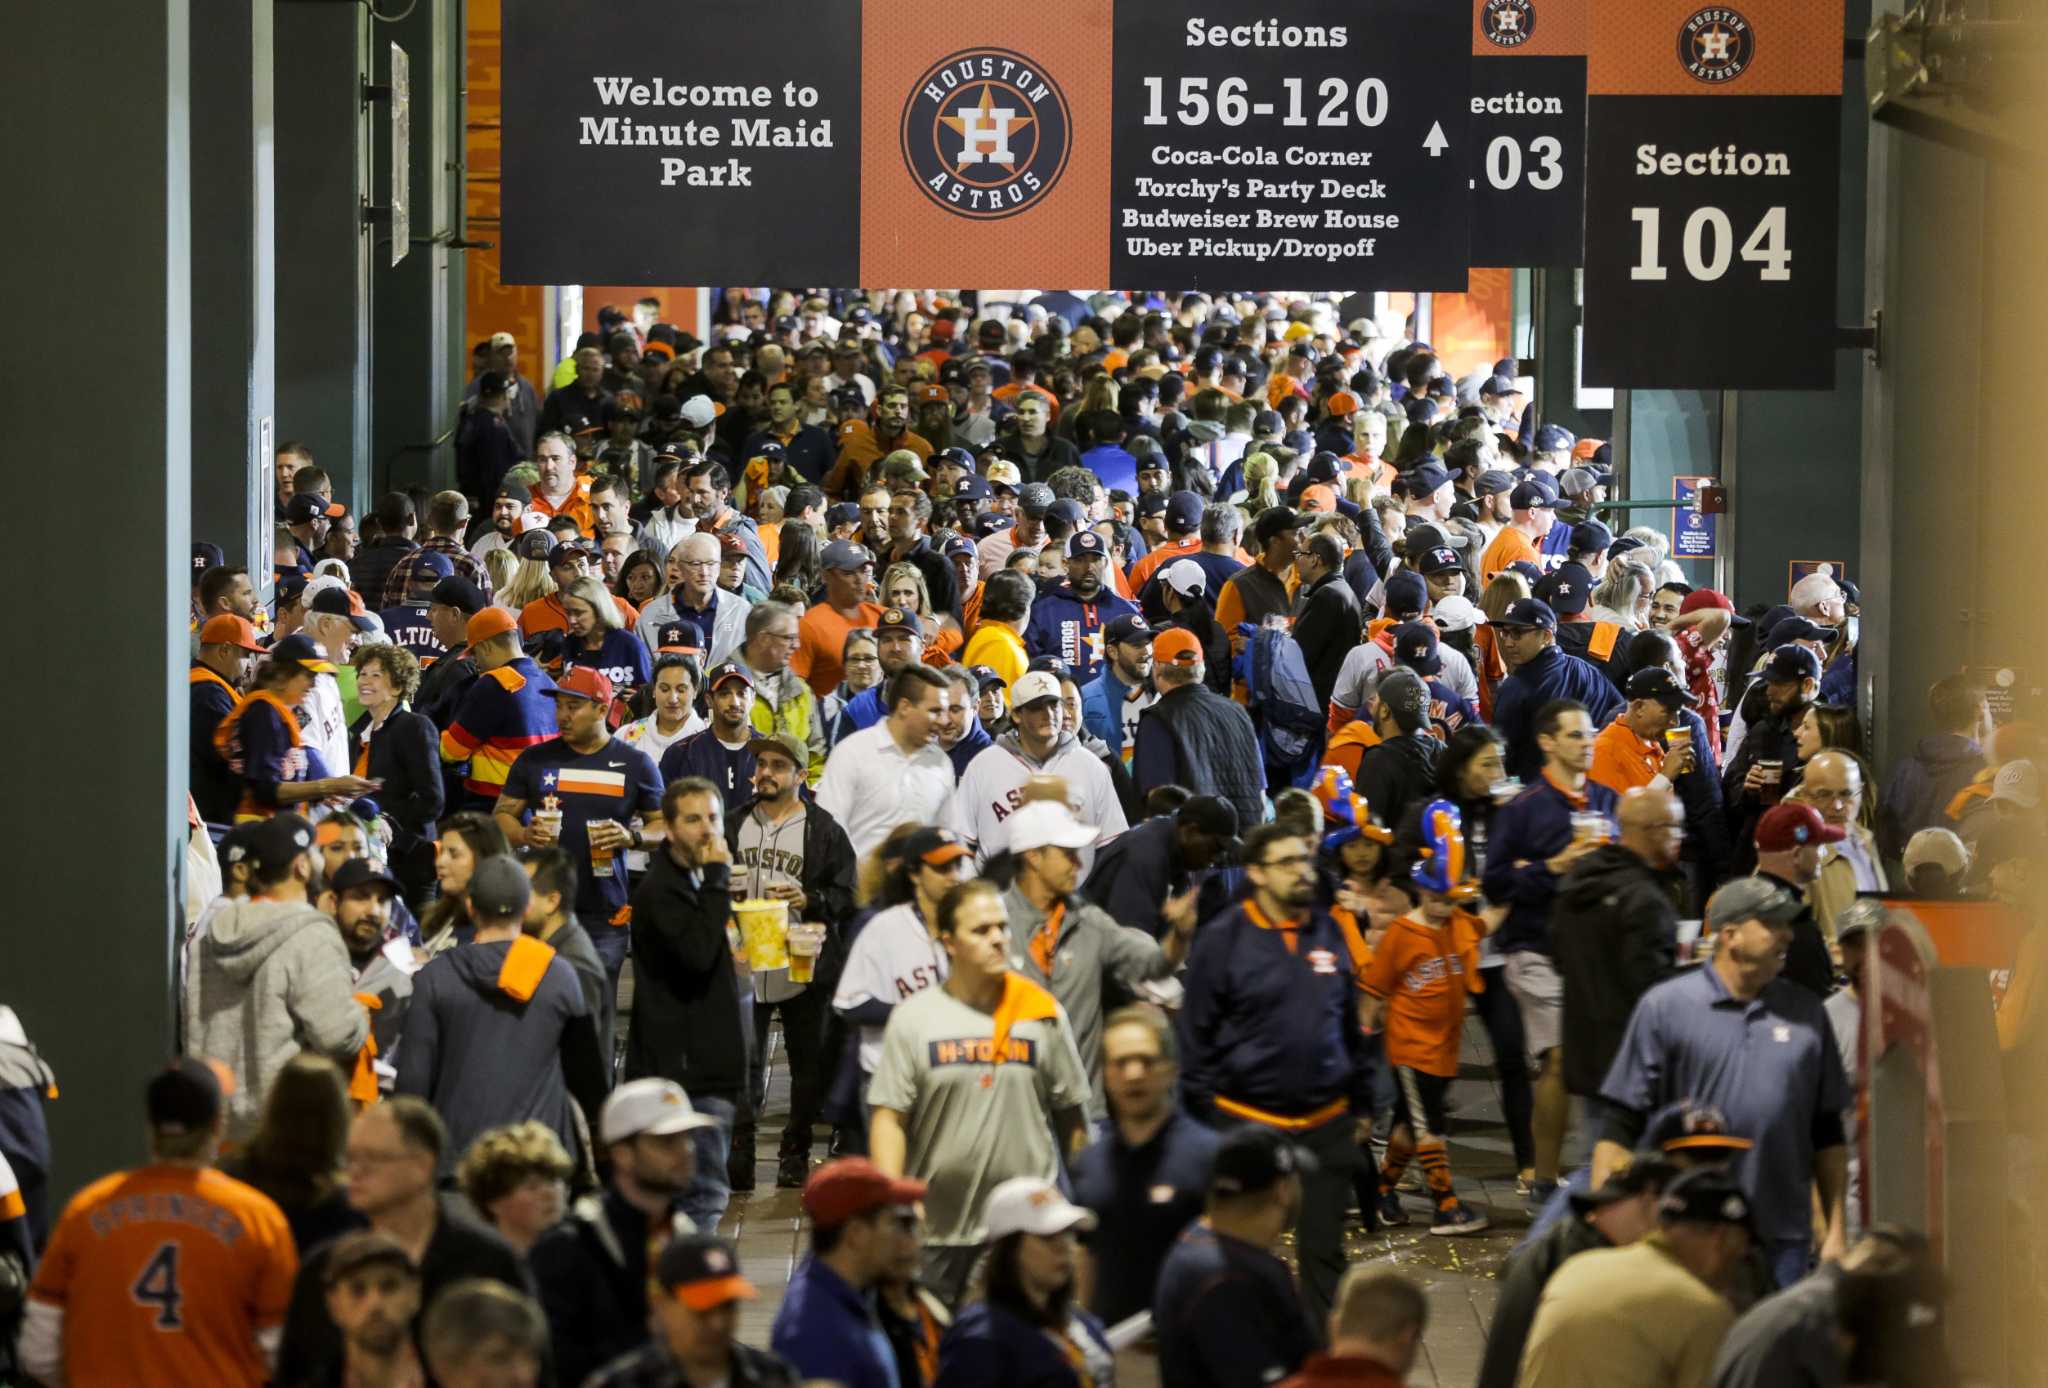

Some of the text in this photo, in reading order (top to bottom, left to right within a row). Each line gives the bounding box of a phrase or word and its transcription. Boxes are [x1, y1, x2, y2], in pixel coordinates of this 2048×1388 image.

[1186, 17, 1348, 48] Sections
[1687, 10, 1745, 32] HOUSTON
[1489, 32, 1527, 45] ASTROS
[1702, 33, 1729, 59] H
[924, 58, 1049, 103] HOUSTON
[1689, 62, 1741, 80] ASTROS
[592, 76, 819, 108] Welcome to
[1143, 76, 1389, 127] 156-120
[1470, 90, 1563, 114] ection
[579, 116, 834, 148] Minute Maid
[957, 107, 1015, 163] H
[1151, 145, 1373, 166] Coca-Cola Corner
[1469, 135, 1563, 190] 03
[1636, 144, 1791, 176] Section
[660, 157, 752, 187] Park
[929, 171, 1041, 209] ASTROS
[1135, 177, 1387, 204] Torchy’s Party Deck
[1122, 208, 1400, 229] Budweiser Brew House
[1126, 237, 1377, 262] Uber Pickup/Dropoff
[1630, 206, 1792, 282] 104
[1061, 620, 1076, 666] ASTROS
[738, 847, 804, 877] USTO
[895, 964, 941, 999] AST
[937, 1039, 1030, 1064] H-TON
[132, 1242, 182, 1331] 4
